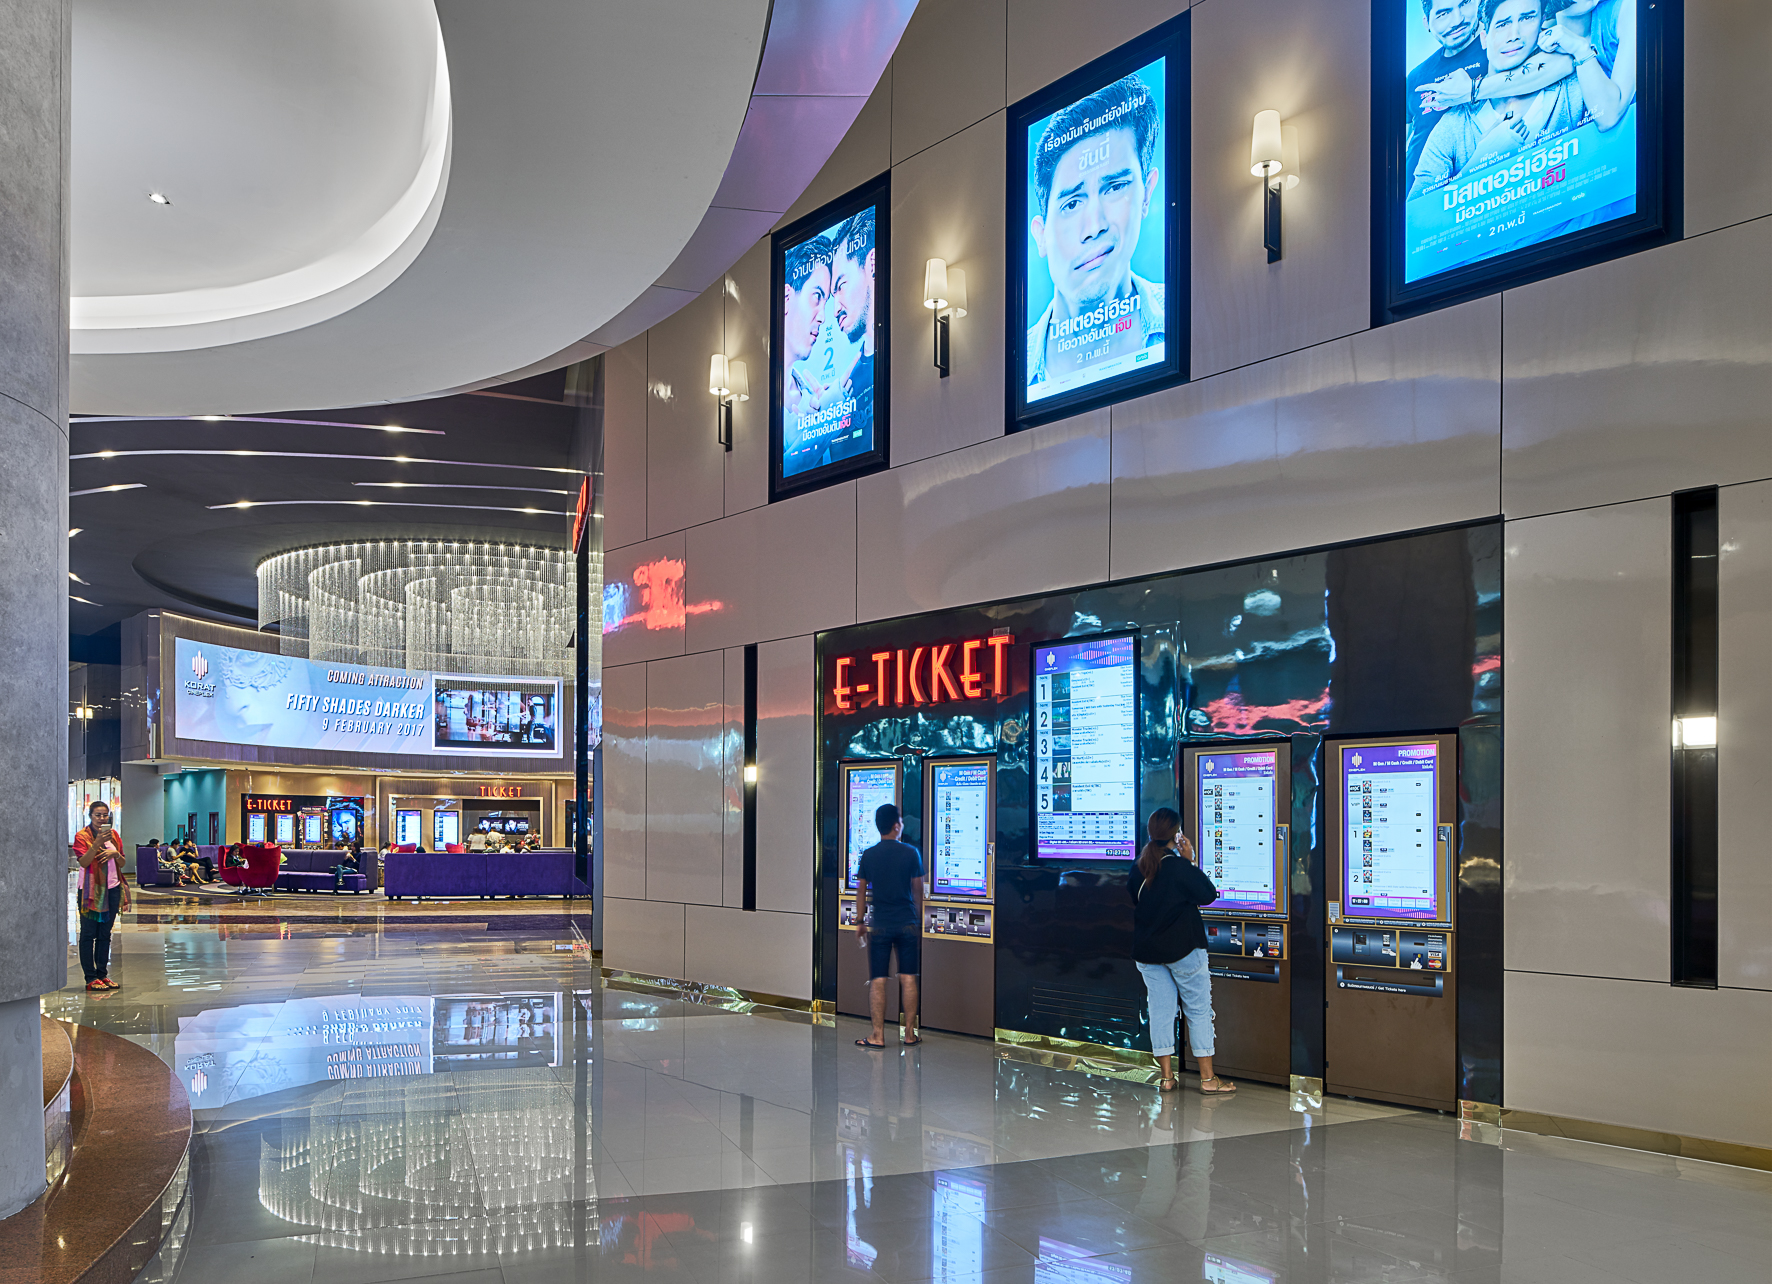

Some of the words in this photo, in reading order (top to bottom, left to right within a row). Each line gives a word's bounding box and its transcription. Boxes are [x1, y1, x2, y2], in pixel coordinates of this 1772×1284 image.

[1443, 138, 1579, 210] มิสเตอร์เฮิร์ท
[1489, 226, 1496, 236] 2
[1049, 292, 1140, 340] มิสเตอร์เฮิร์ท
[823, 346, 834, 372] 2
[1076, 353, 1083, 364] 2
[327, 670, 365, 685] COMING
[368, 674, 424, 689] ATTRACTION
[833, 634, 1014, 710] E-TICKET
[185, 680, 216, 692] KORAT
[1041, 684, 1046, 700] 1
[286, 693, 320, 711] FIFTY
[322, 697, 371, 716] SHADES
[374, 701, 425, 720] DARKER
[322, 718, 329, 731] 9
[334, 719, 392, 735] FEBRUARY
[397, 723, 424, 736] 2017
[1040, 711, 1048, 727] 2
[1041, 738, 1047, 755] 3
[1398, 749, 1435, 757] PROMOTION
[1041, 766, 1048, 782] 4
[480, 786, 522, 797] TICKET
[247, 799, 292, 810] E-TICKET
[1041, 793, 1048, 810] 5
